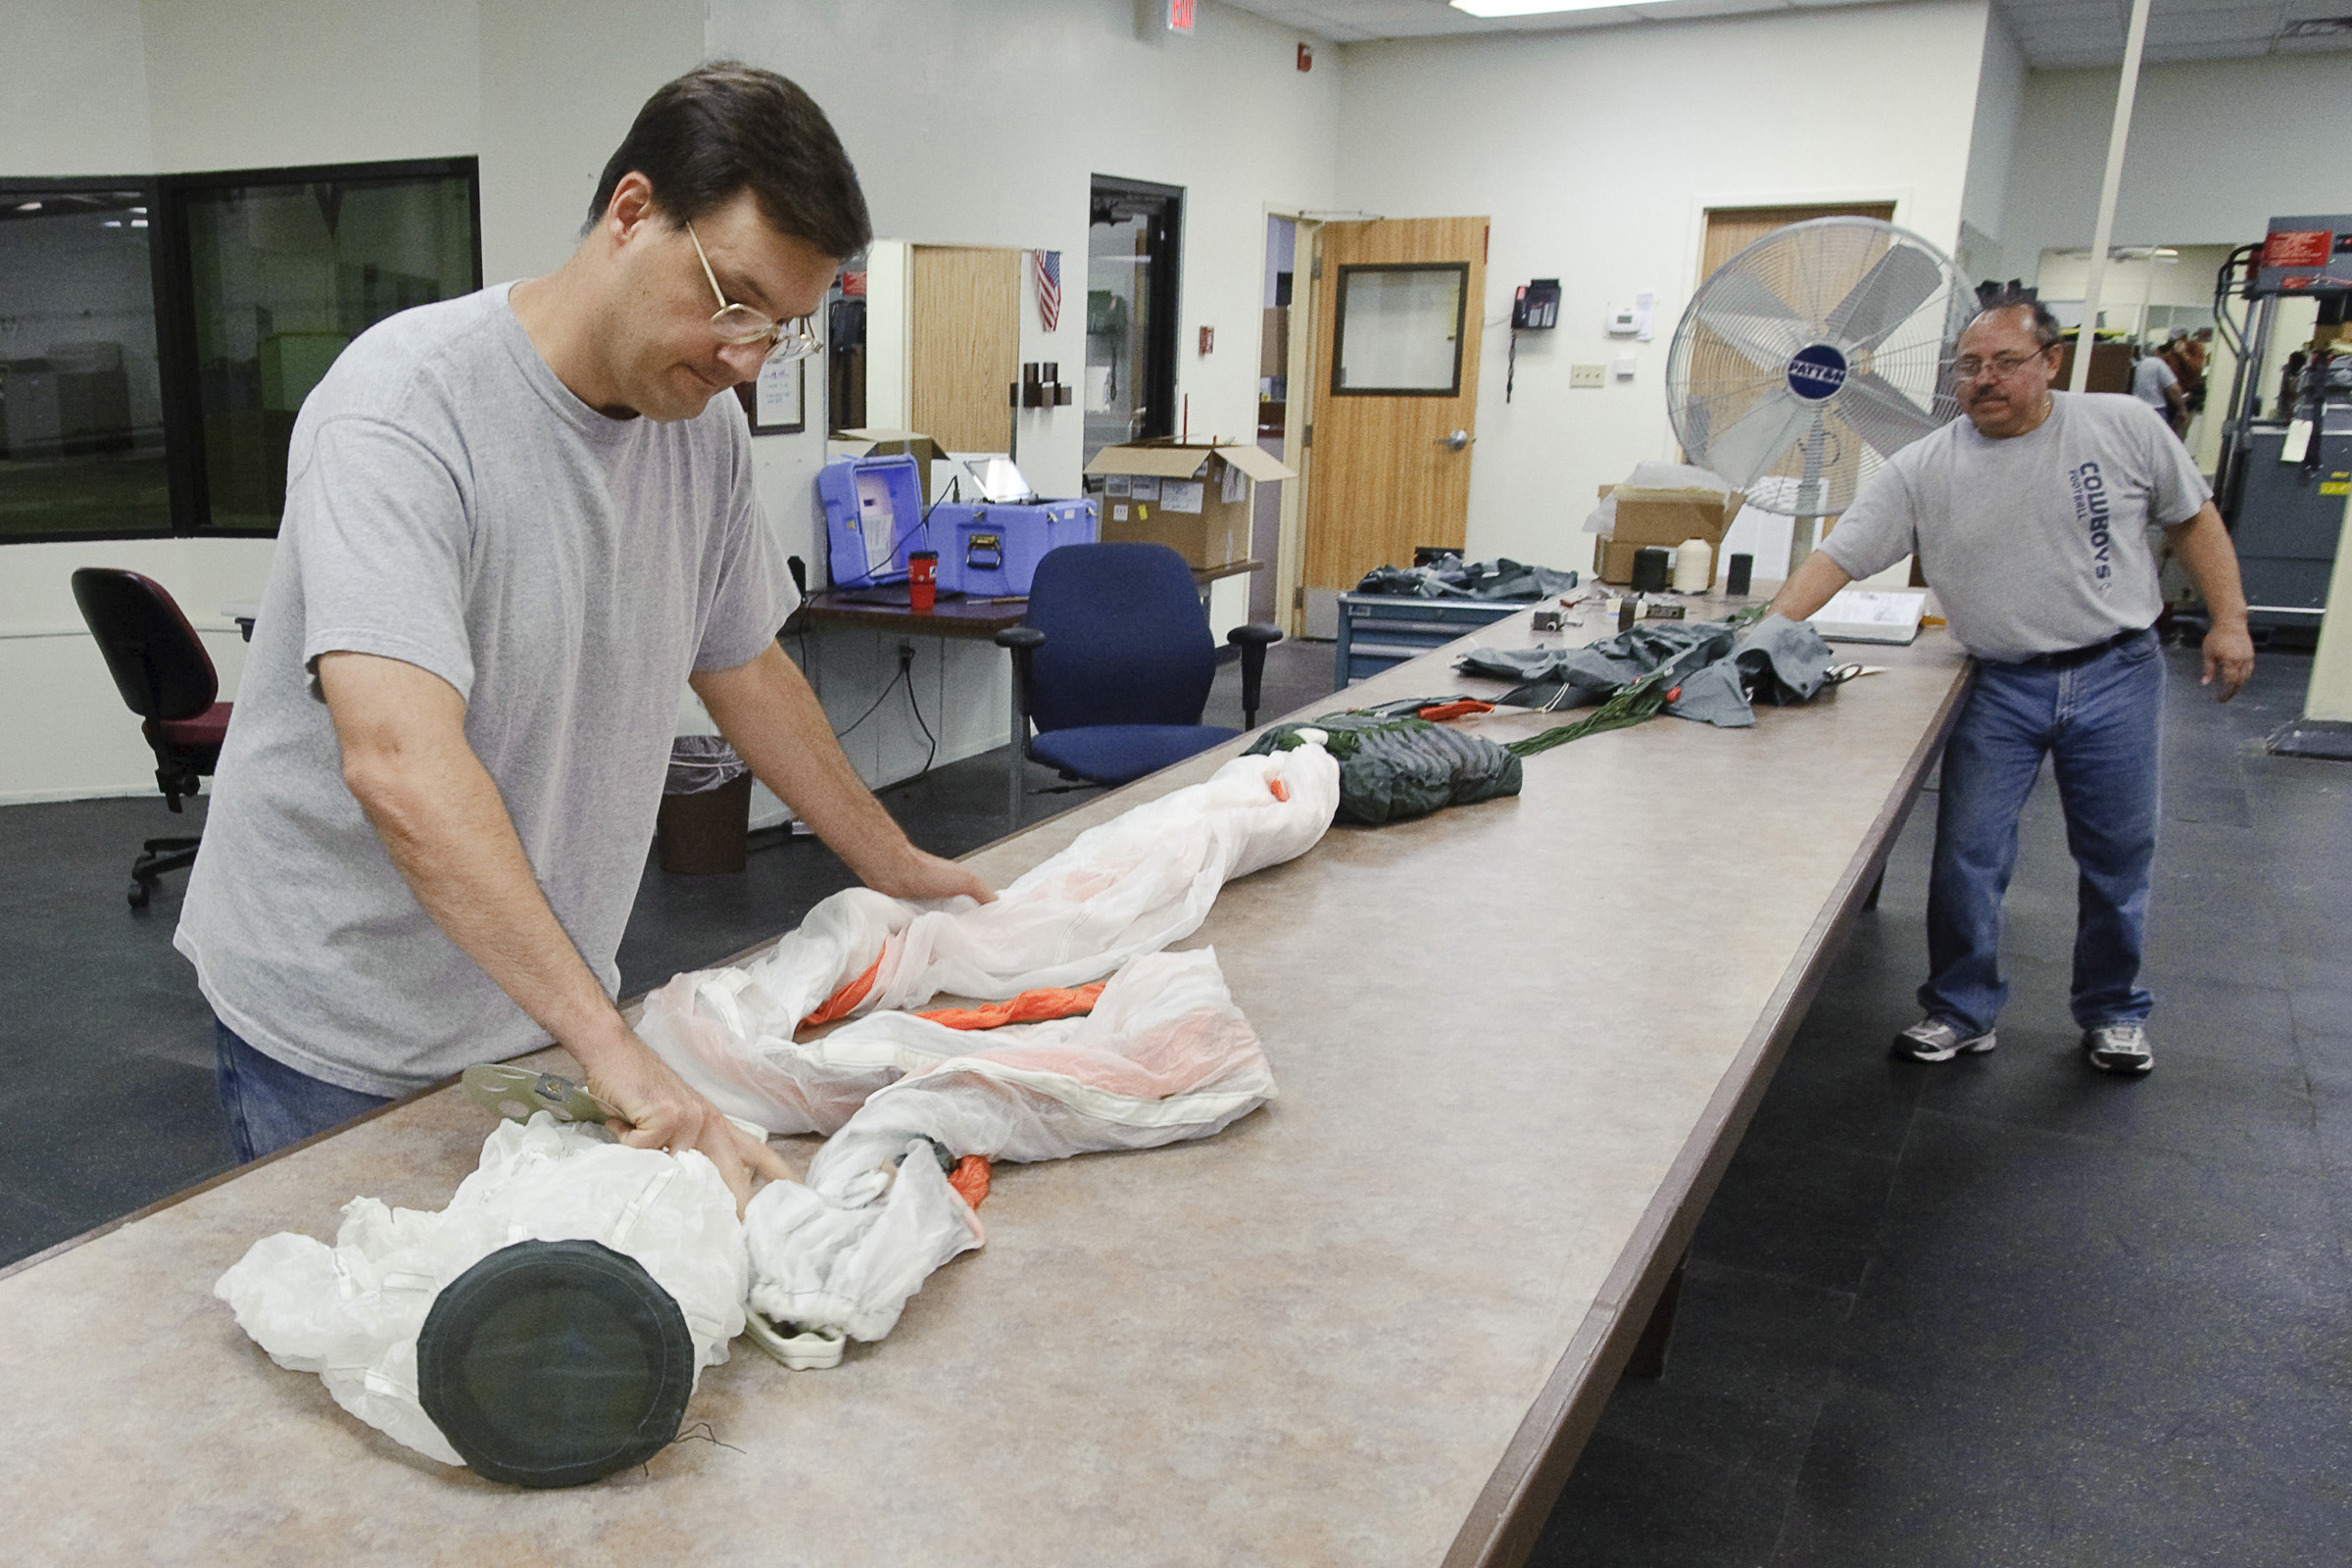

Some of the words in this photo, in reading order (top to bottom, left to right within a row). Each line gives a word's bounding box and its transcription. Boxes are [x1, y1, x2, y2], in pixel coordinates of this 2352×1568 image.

[1788, 360, 1846, 384] PATTON
[2069, 468, 2087, 520] FOOTBALL
[2080, 462, 2111, 579] COWBOYS
